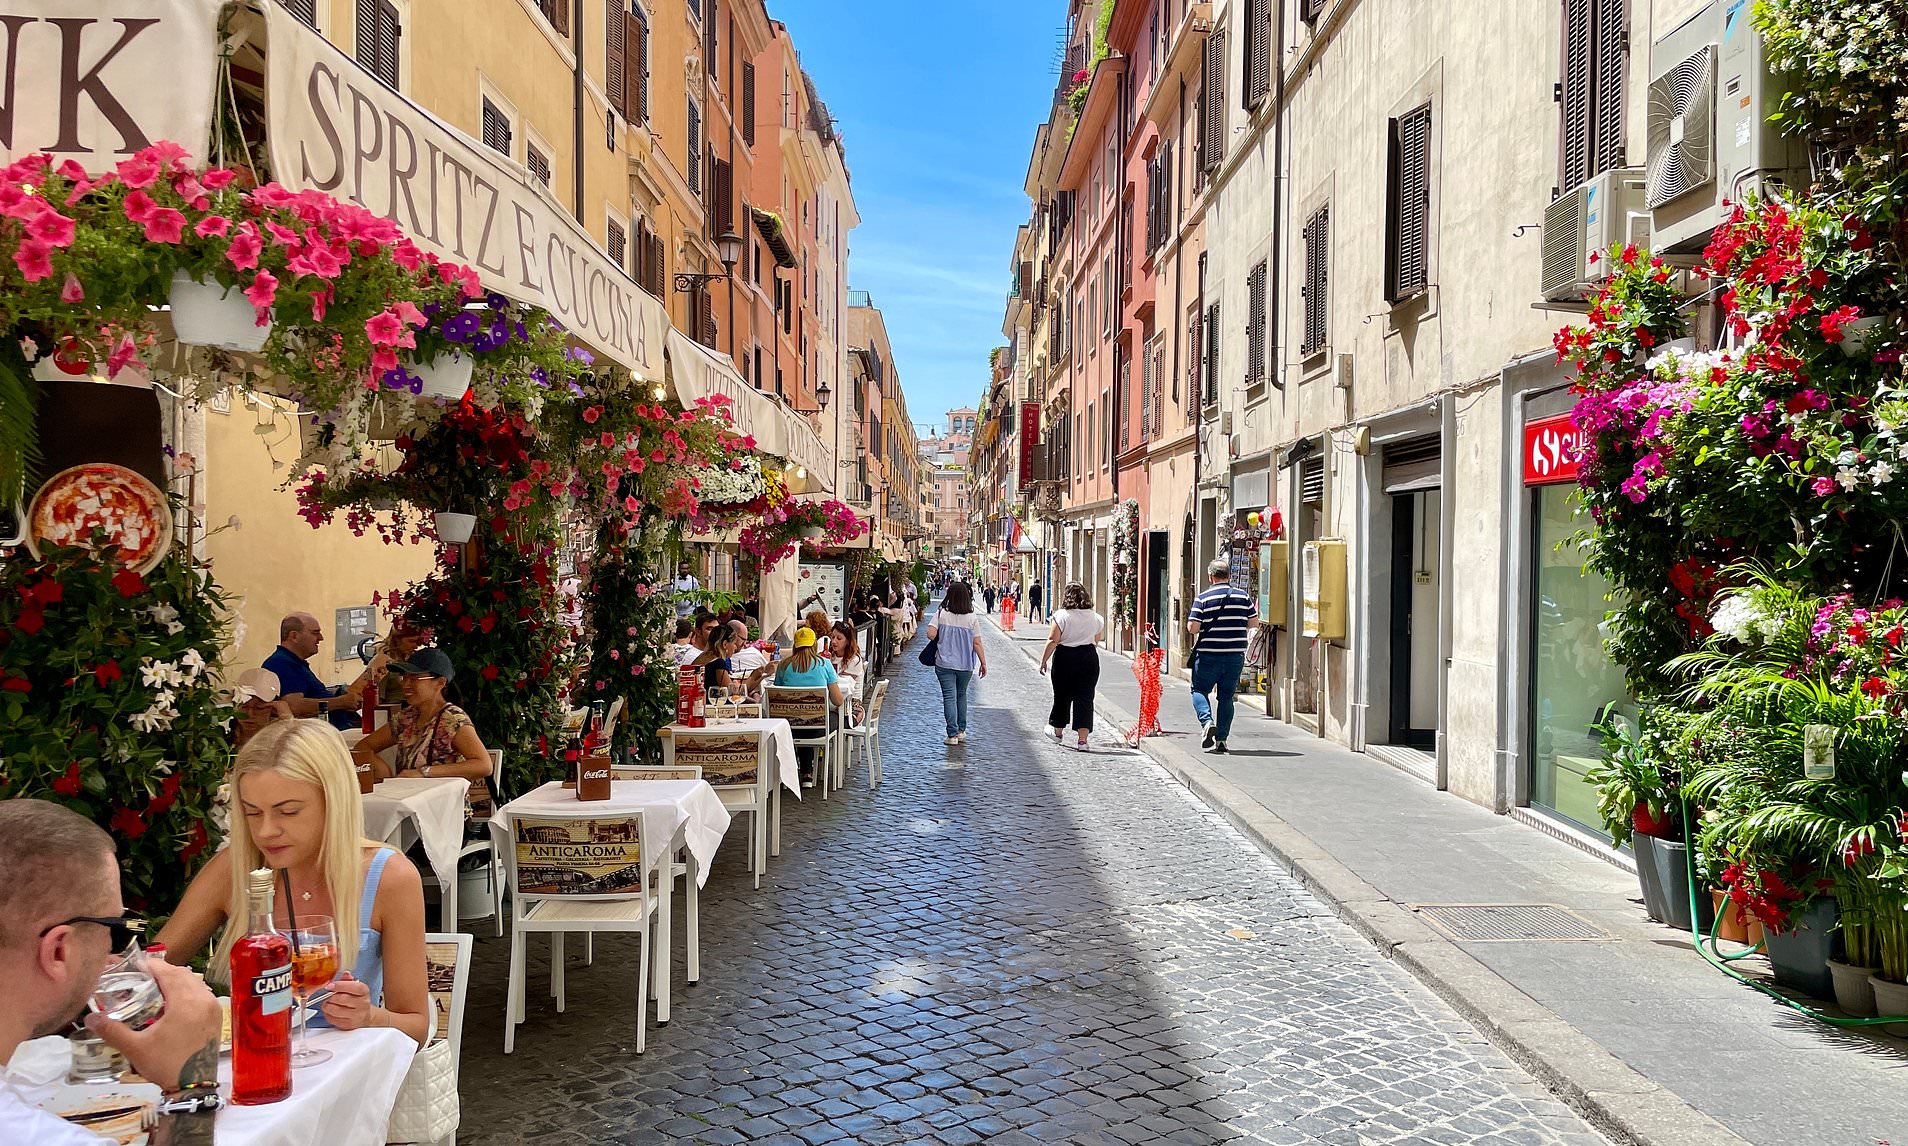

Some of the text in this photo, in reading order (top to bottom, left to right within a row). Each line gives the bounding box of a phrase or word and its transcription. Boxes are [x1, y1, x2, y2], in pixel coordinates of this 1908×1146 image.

[300, 61, 650, 369] SPRITZ E CUCINA
[676, 753, 756, 762] ANTICAROMA
[529, 844, 627, 858] ANTICAROMA
